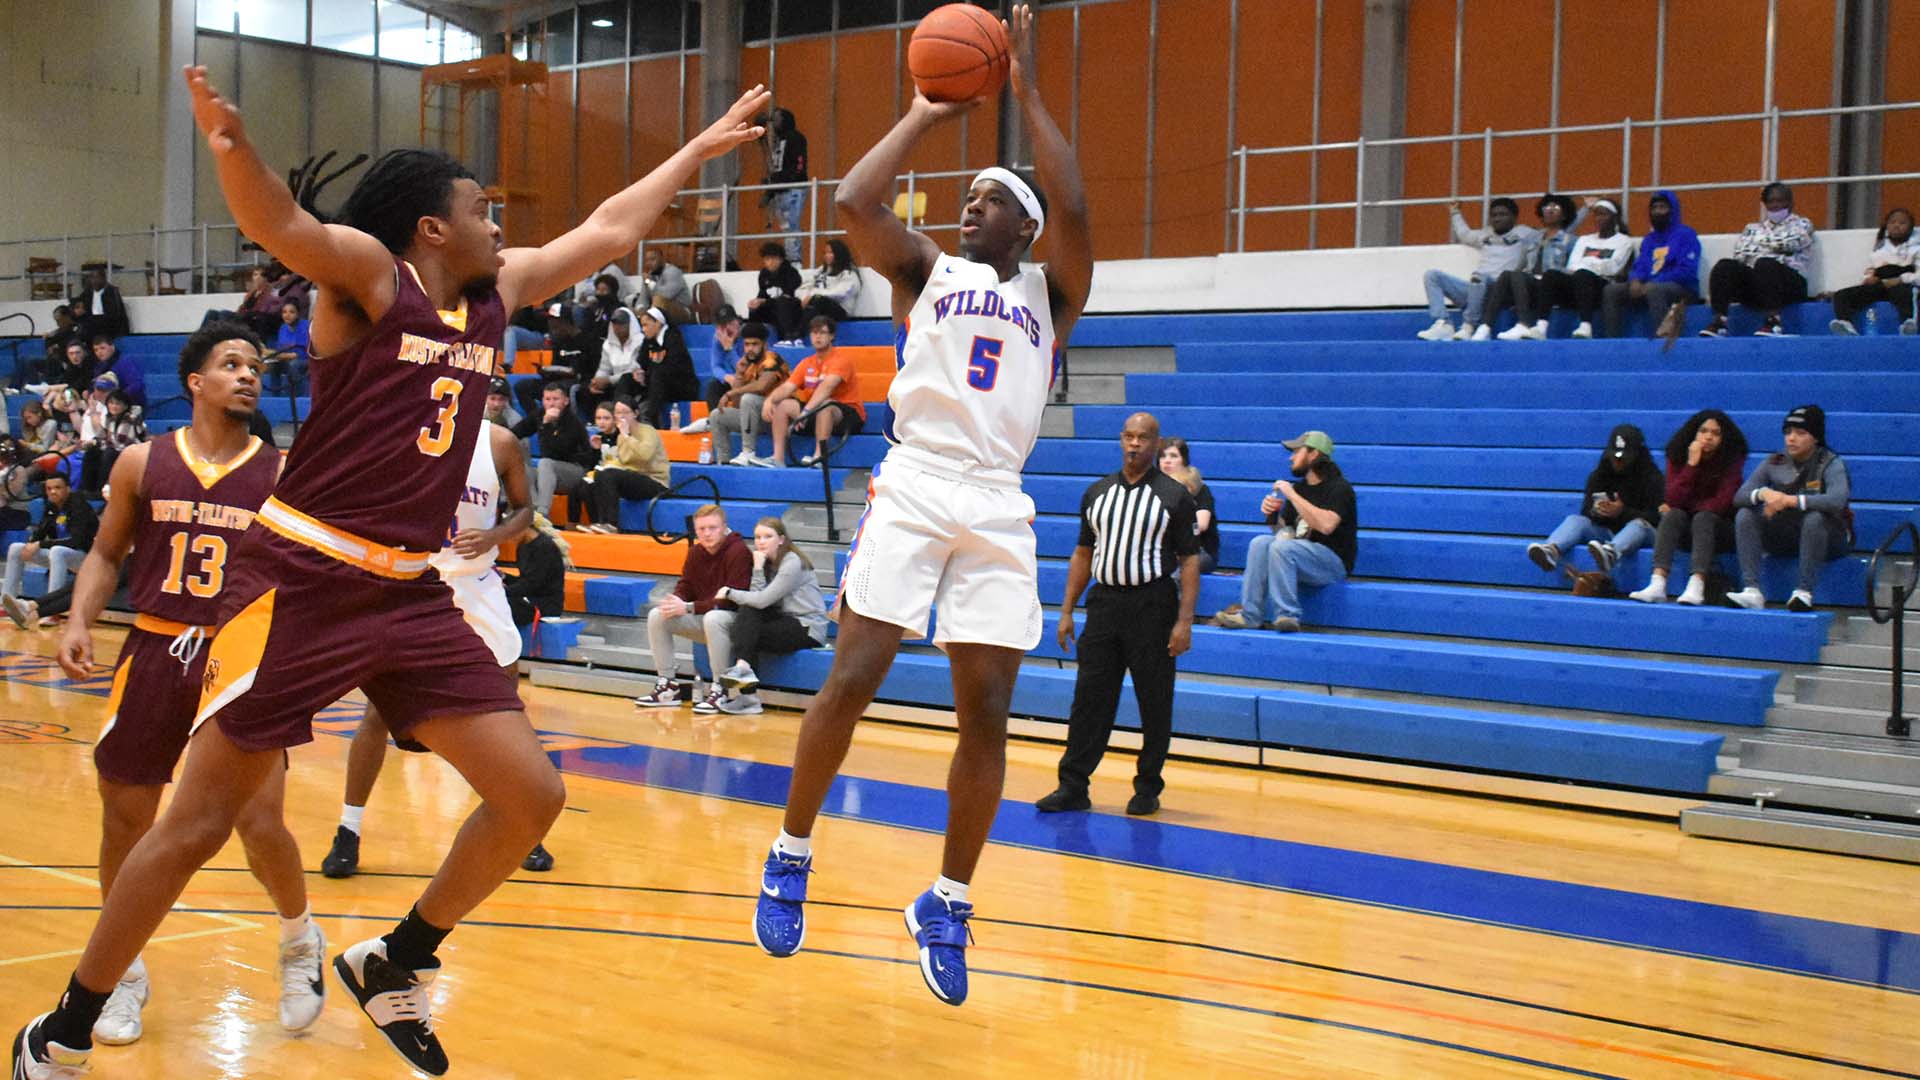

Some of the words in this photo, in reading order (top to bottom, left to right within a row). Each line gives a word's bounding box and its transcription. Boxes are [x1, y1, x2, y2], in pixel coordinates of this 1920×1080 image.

[934, 289, 1040, 348] WILDCATS
[966, 335, 1004, 392] 5
[416, 376, 464, 457] 3
[160, 531, 228, 598] 13
